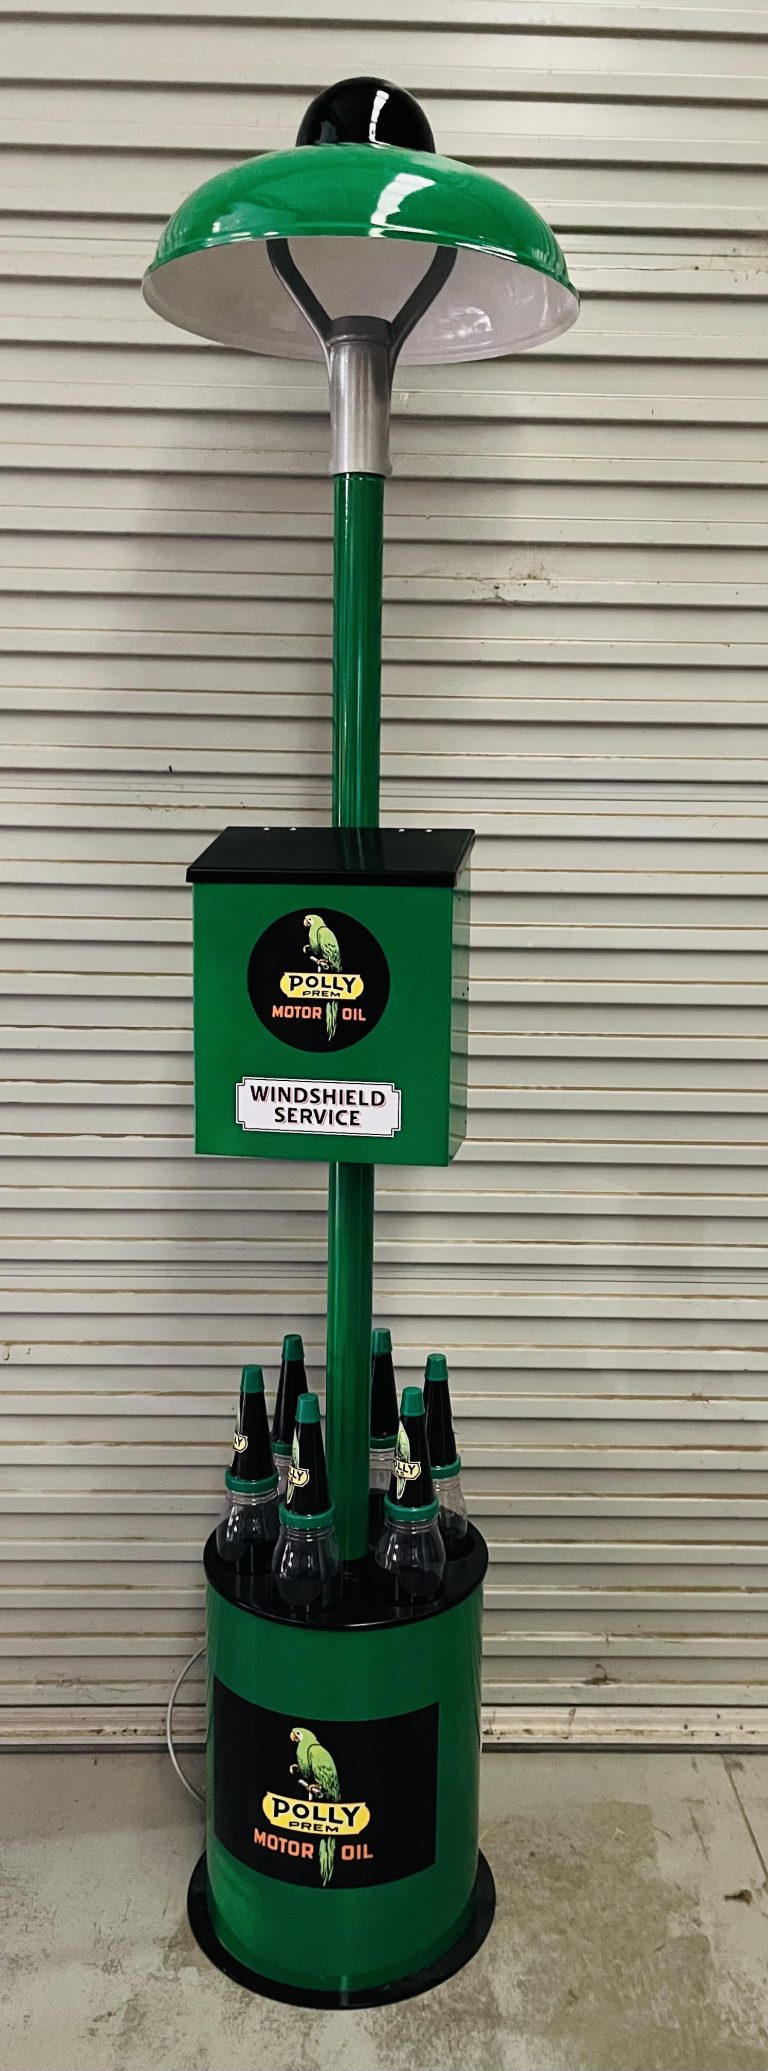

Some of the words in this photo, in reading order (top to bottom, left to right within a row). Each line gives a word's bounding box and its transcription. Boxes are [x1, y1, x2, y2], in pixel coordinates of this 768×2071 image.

[289, 975, 356, 993] POLLY
[302, 990, 341, 998] PREM
[272, 1005, 322, 1019] MOTOR
[342, 1007, 366, 1021] OIL
[250, 1085, 386, 1107] WINDSHIELD
[274, 1107, 361, 1127] SERVICE
[393, 1460, 416, 1475] OLLY
[272, 1797, 360, 1827] POLLY
[289, 1821, 339, 1833] PREM
[254, 1828, 314, 1859] MOTOR
[341, 1843, 373, 1860] OIL
